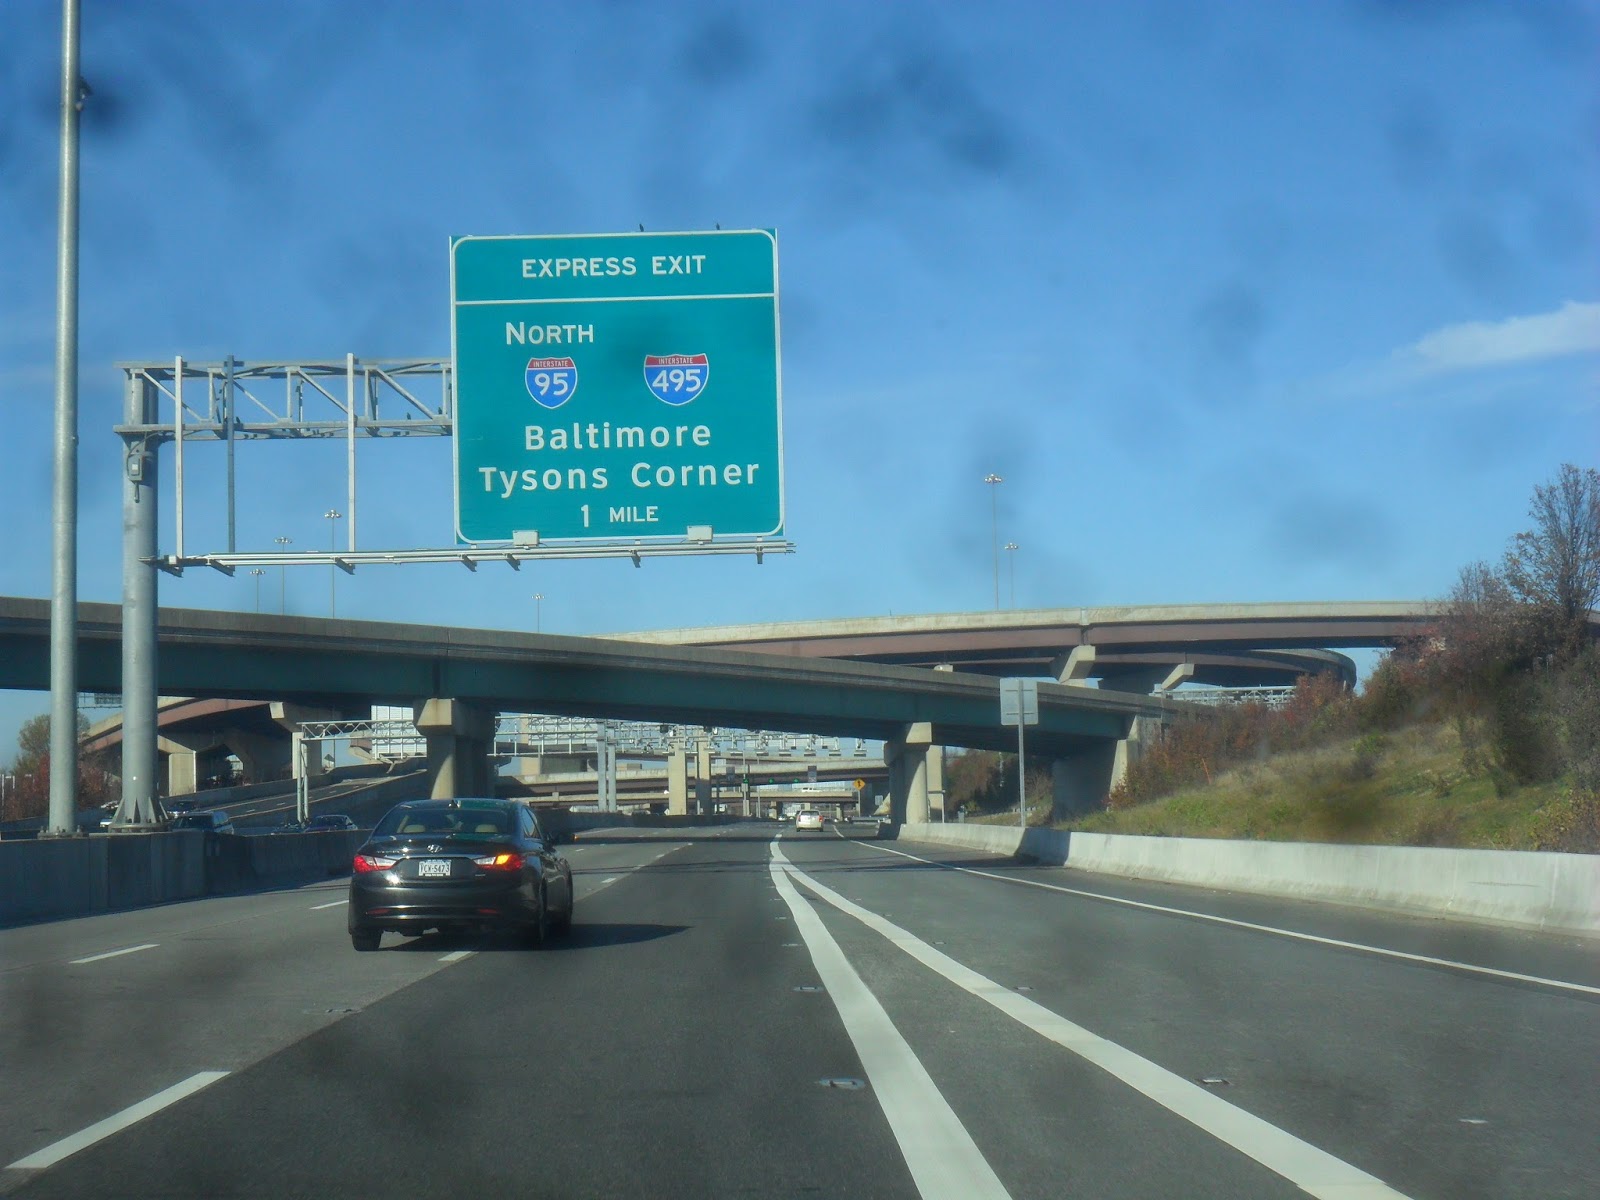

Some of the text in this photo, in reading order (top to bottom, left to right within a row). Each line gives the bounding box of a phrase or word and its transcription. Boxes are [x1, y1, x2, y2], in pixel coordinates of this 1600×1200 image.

[521, 254, 706, 279] EXPRESS EXIT
[505, 321, 595, 345] NORTH
[533, 360, 569, 368] INTERSTATE
[658, 357, 694, 365] INTERSTATE
[534, 372, 569, 396] 95
[652, 368, 701, 393] 495
[525, 421, 711, 450] Baltimore
[478, 462, 759, 498] Tysons Corner
[580, 504, 659, 528] 1 MILE
